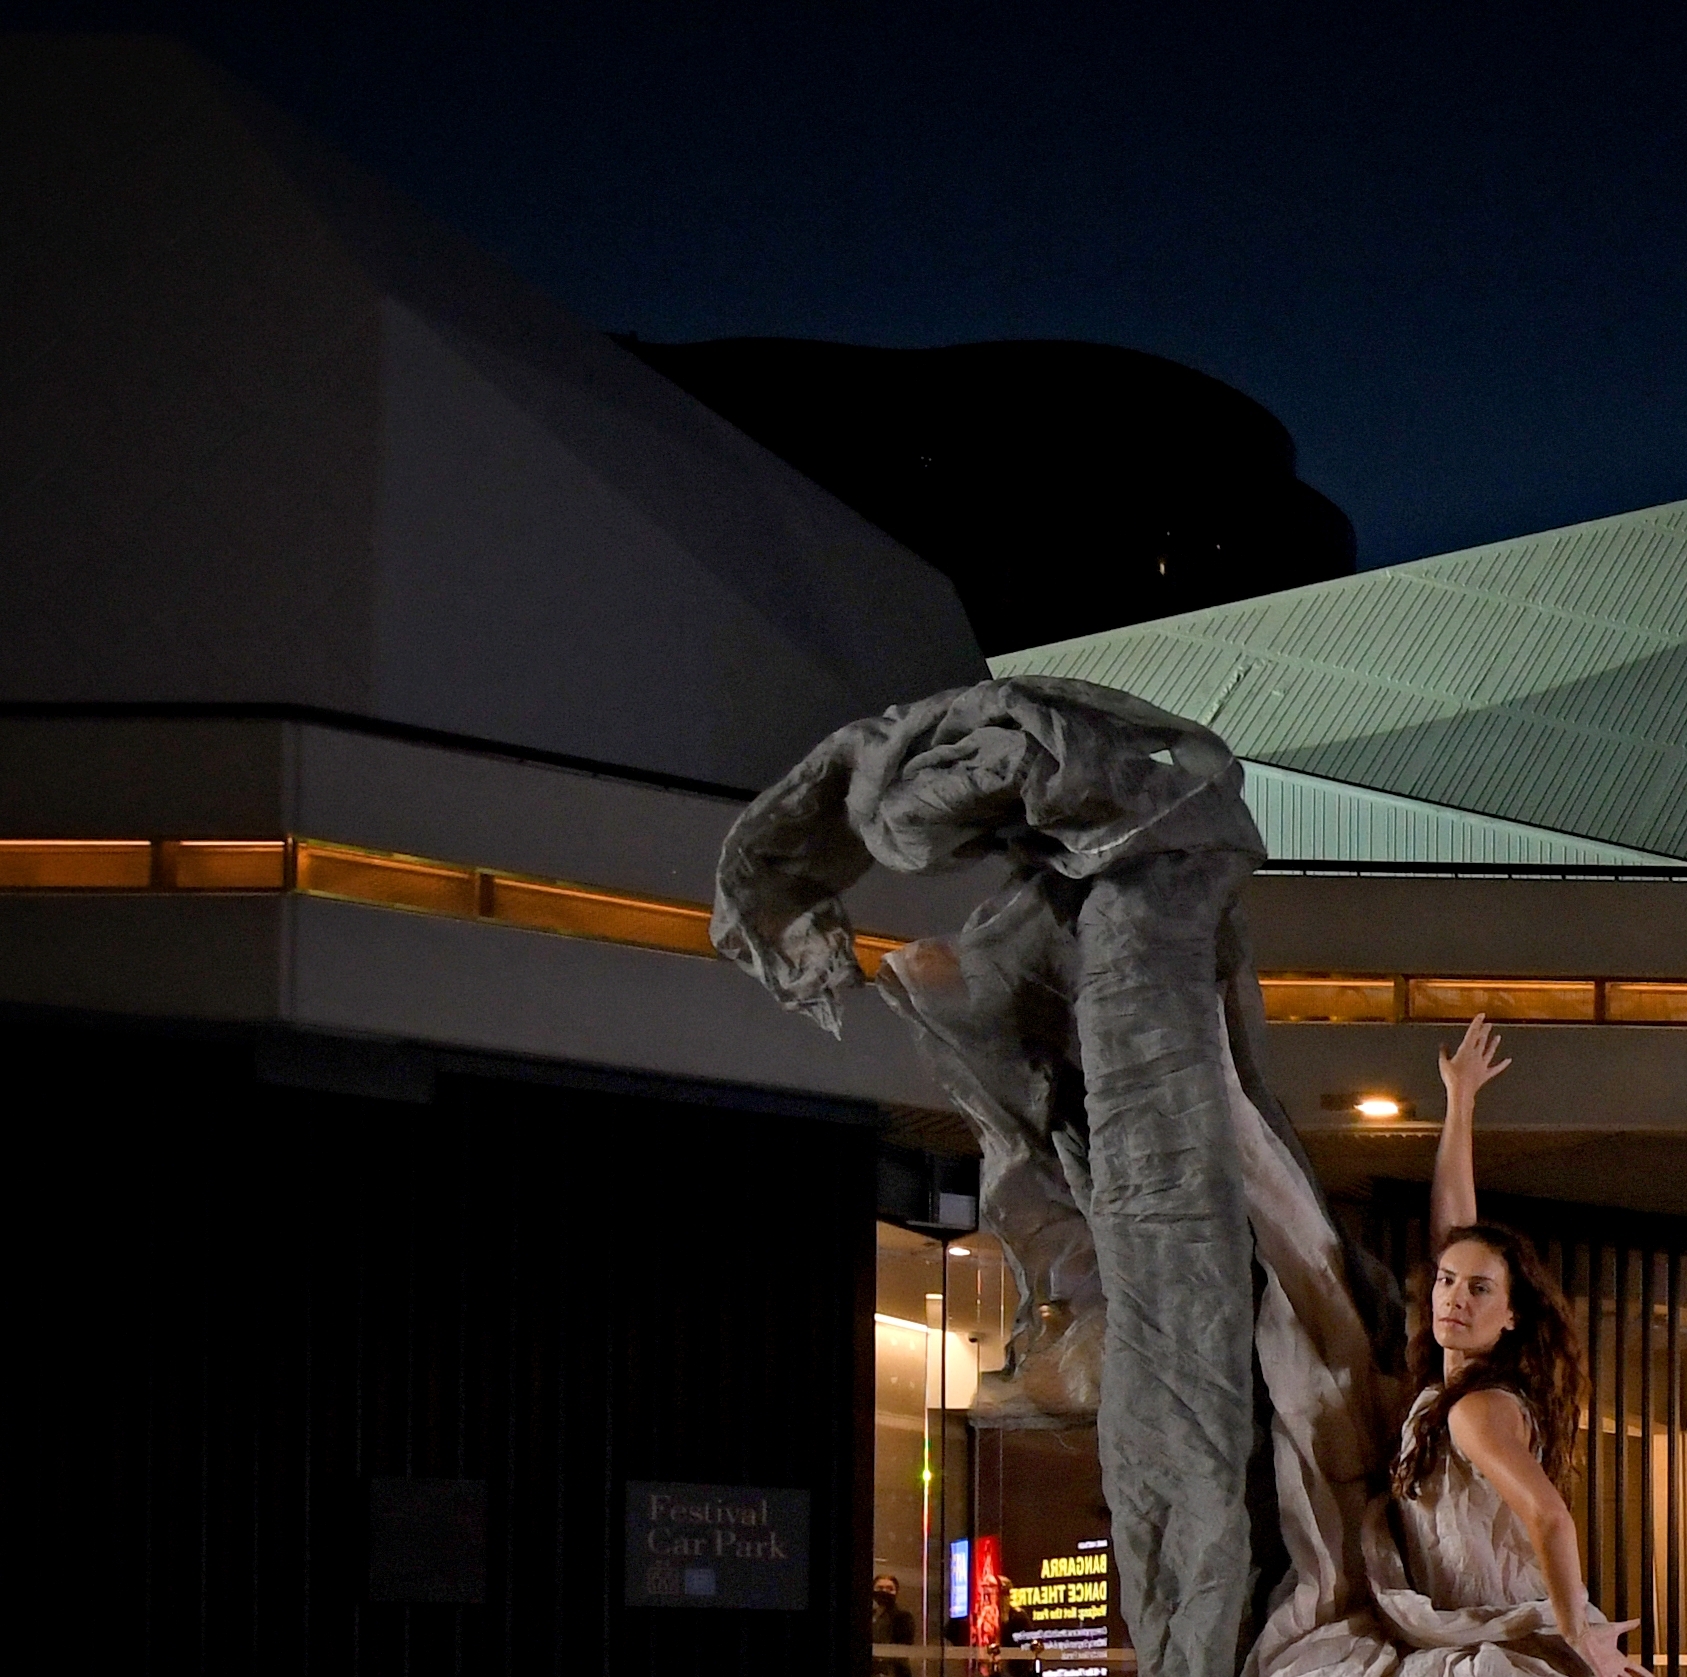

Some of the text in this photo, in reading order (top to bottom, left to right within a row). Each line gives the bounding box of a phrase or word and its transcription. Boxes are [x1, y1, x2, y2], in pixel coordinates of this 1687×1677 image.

[649, 1494, 767, 1526] Festival
[647, 1528, 787, 1558] Car Park
